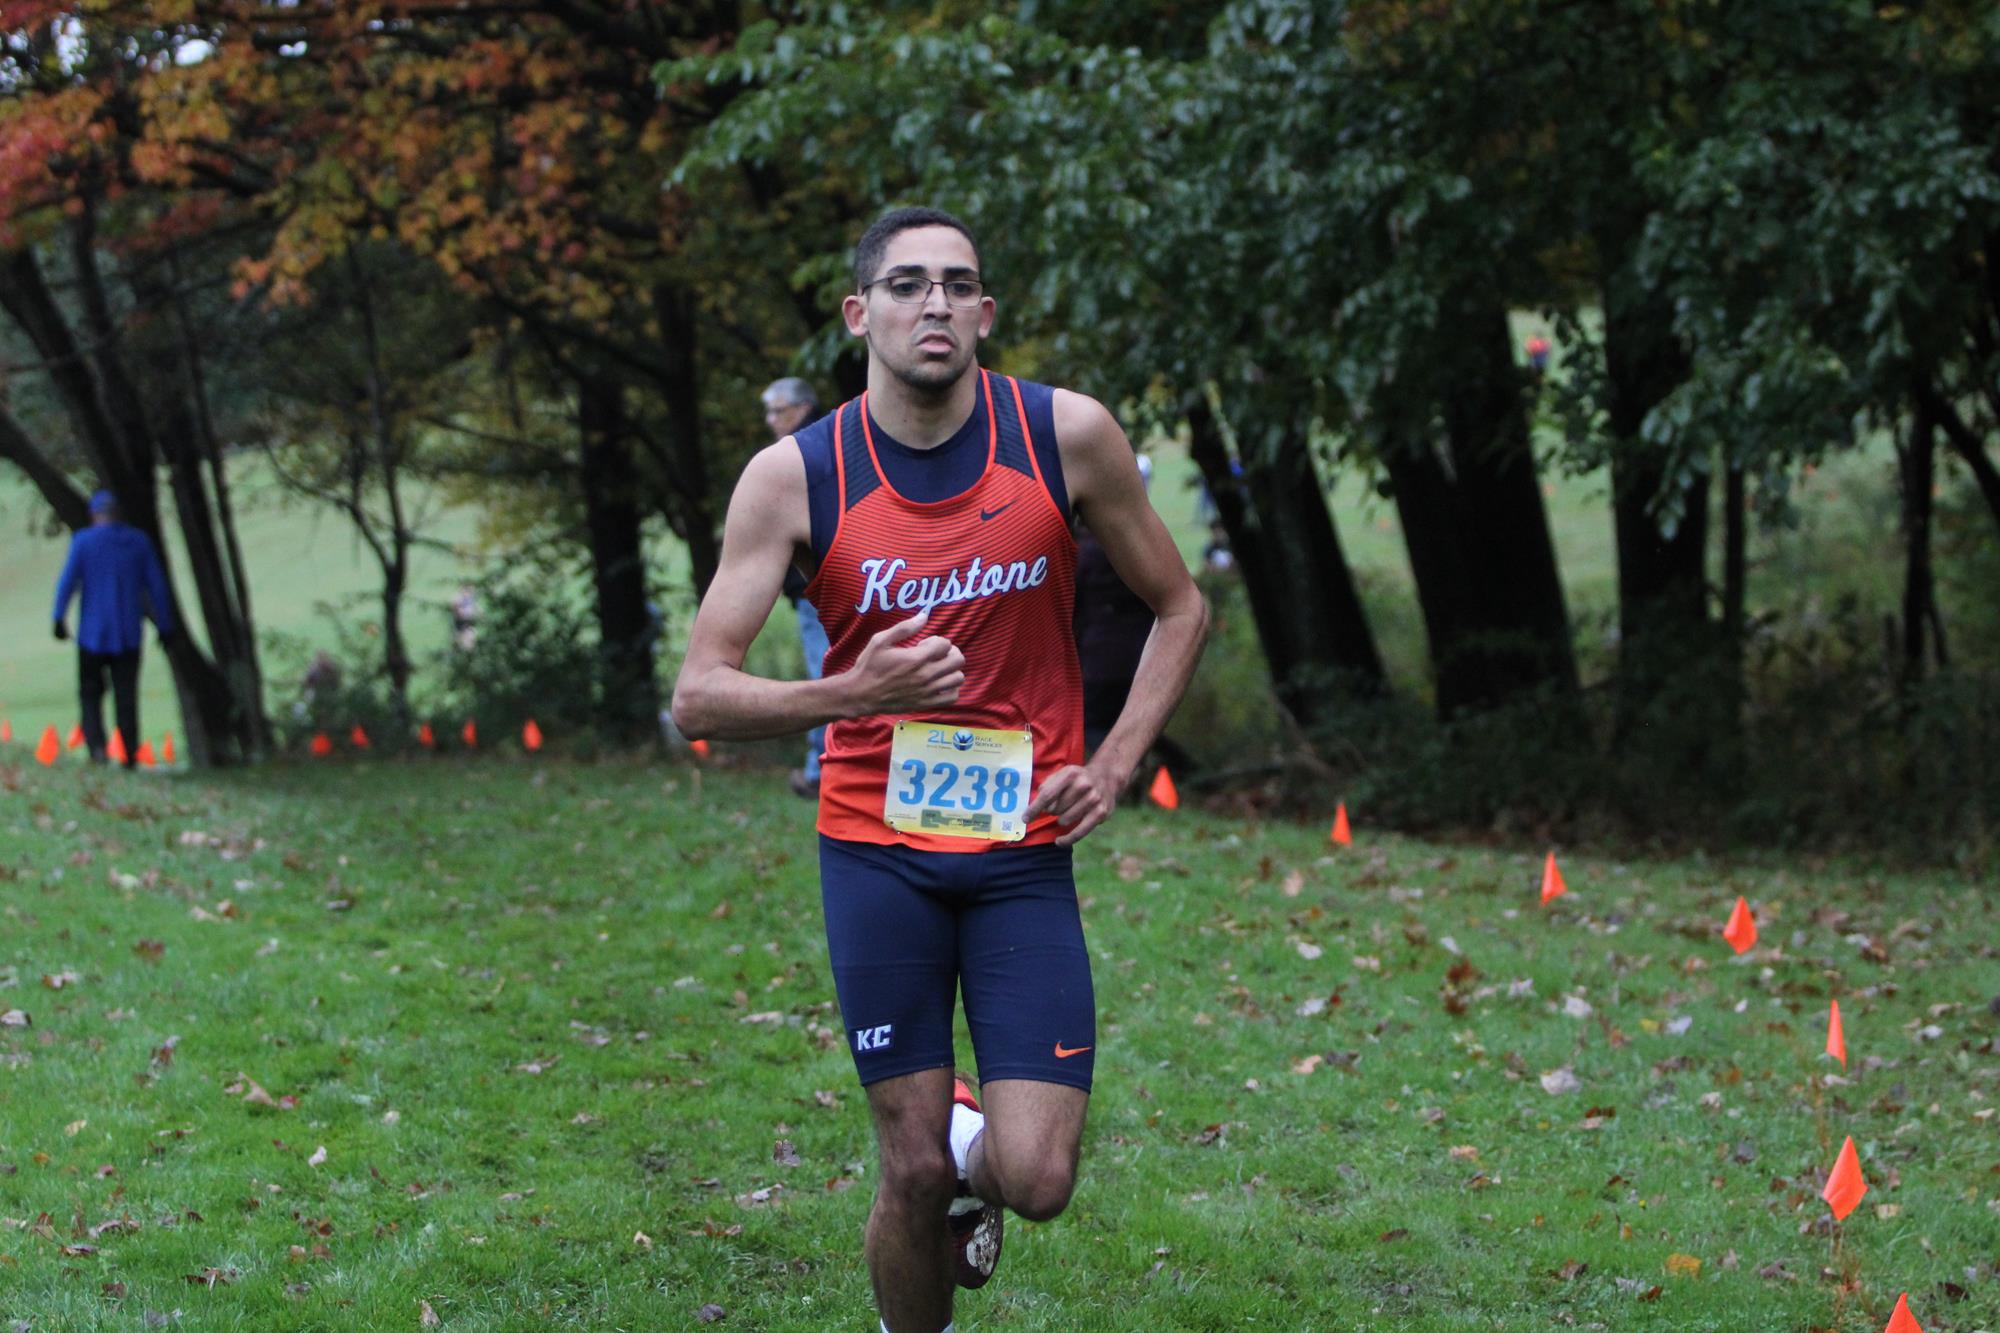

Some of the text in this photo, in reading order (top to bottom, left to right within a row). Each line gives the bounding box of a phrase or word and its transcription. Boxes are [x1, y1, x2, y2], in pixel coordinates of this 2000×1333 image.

[854, 556, 1048, 615] Keystone
[927, 729, 953, 745] 2L
[898, 758, 1021, 814] 3238
[856, 1024, 892, 1051] KC
